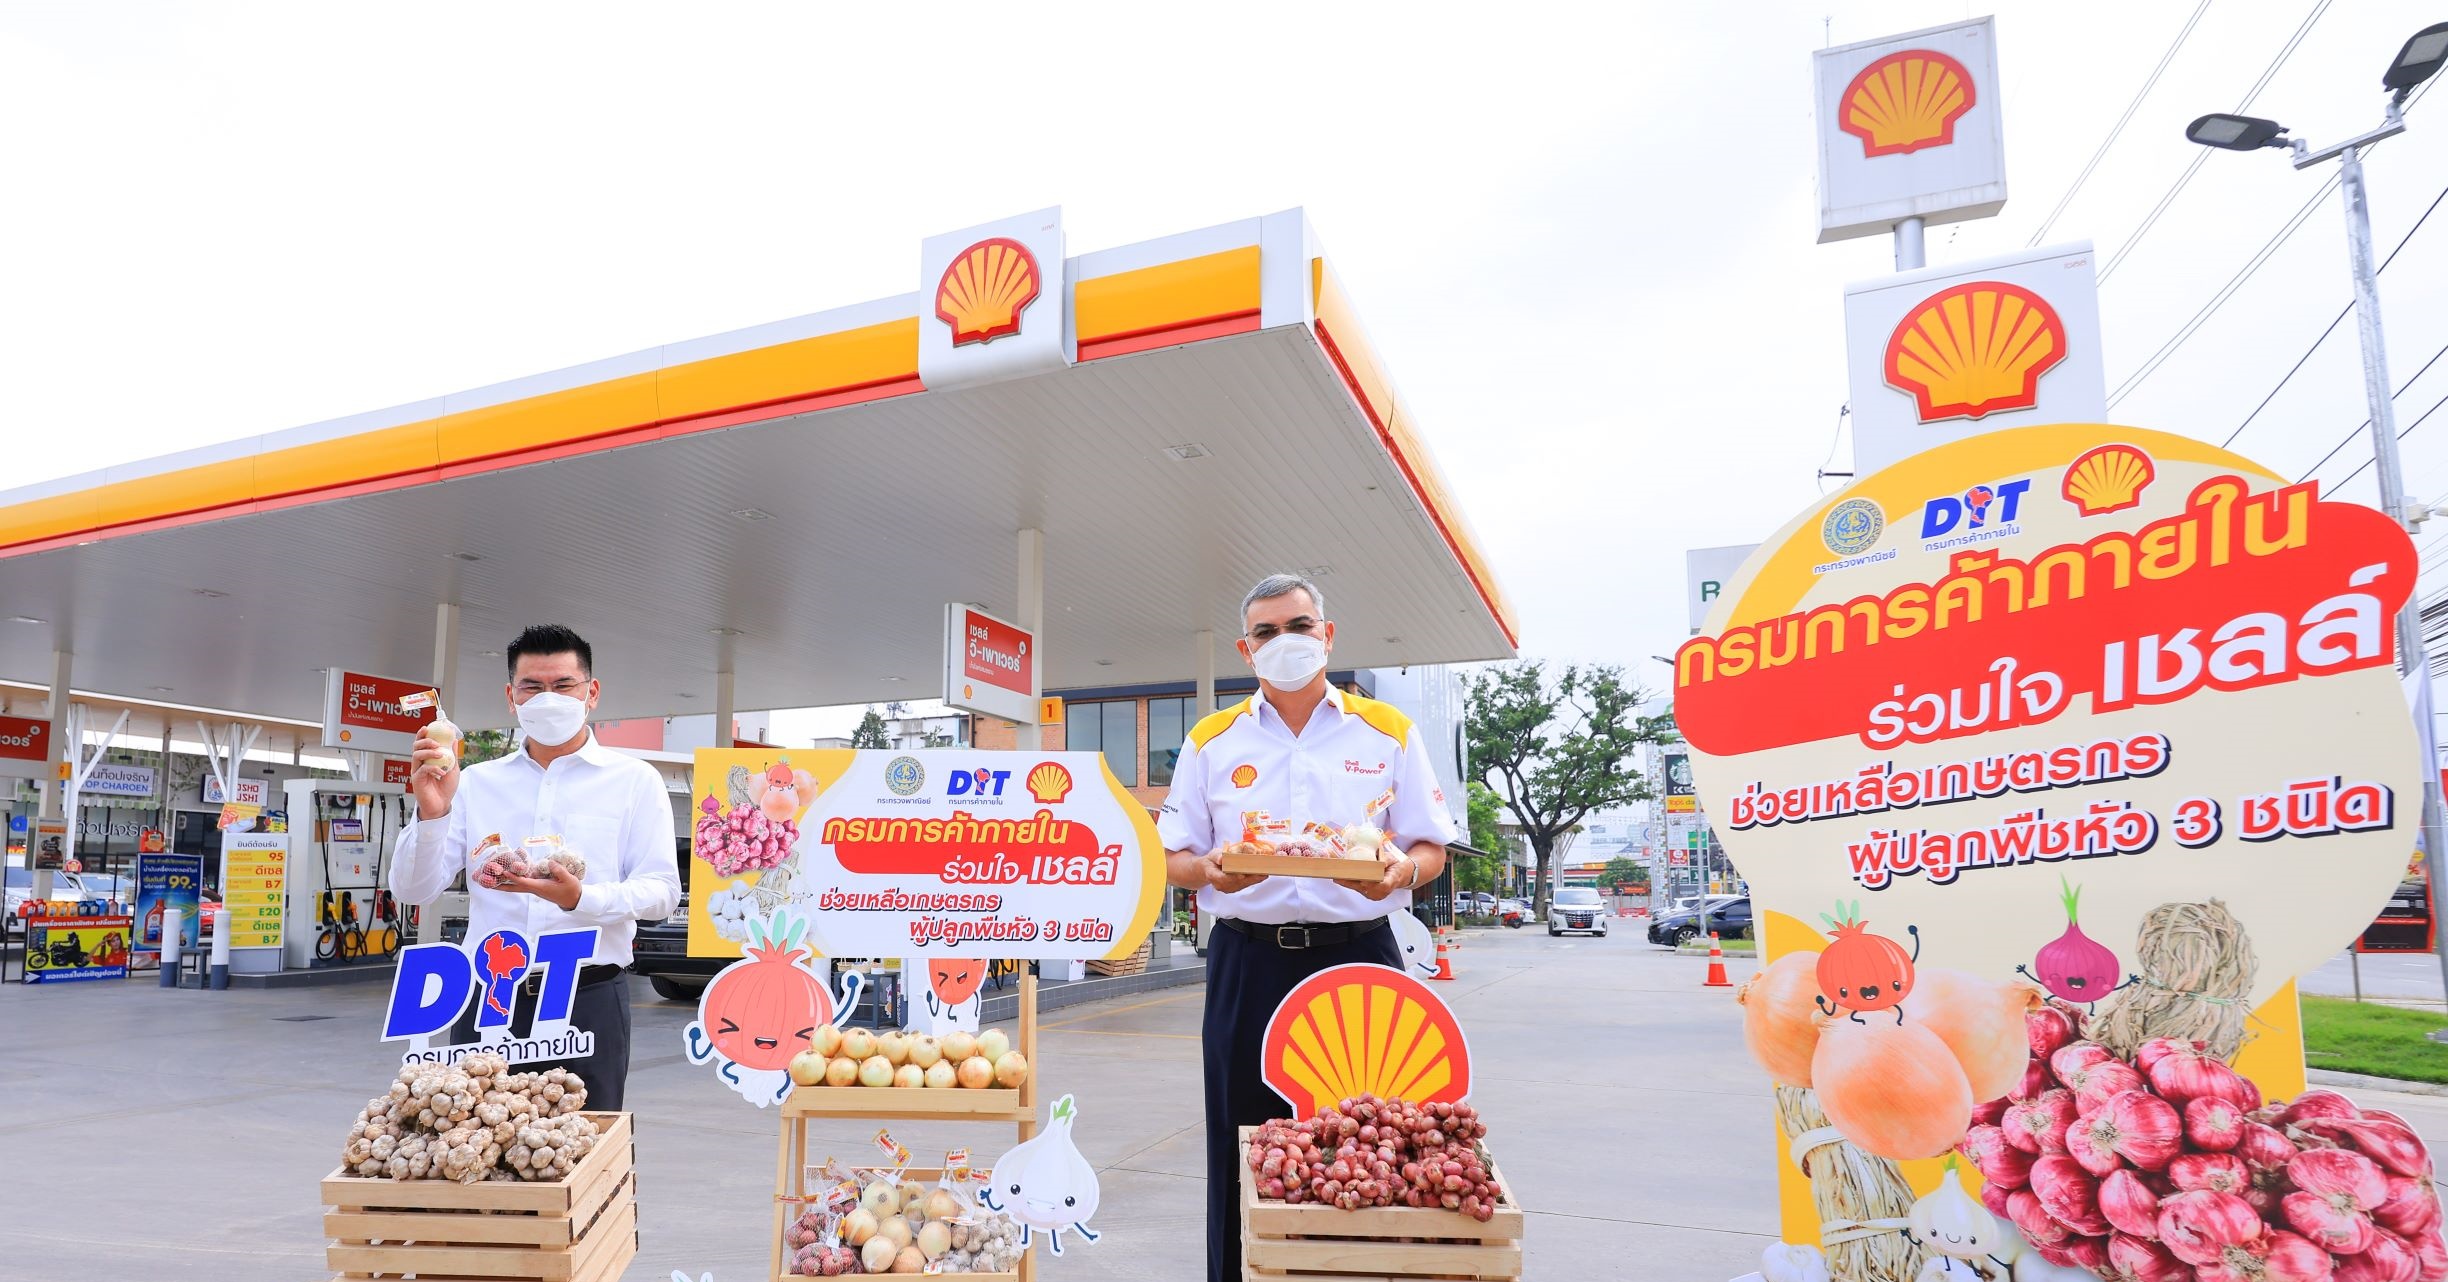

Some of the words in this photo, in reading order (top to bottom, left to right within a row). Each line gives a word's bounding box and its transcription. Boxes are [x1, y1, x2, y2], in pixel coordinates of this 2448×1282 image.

[1921, 479, 2031, 539] DIT
[1925, 523, 2020, 552] กรมการค้าภายใน
[1814, 549, 1897, 574] กระทรวงพาณิชย์
[1677, 480, 2314, 688] กรมการค้าภายใน
[970, 624, 989, 640] เชลล์
[1868, 657, 2063, 744] ร่วมใจ
[2103, 562, 2388, 705] เชลล์
[349, 683, 376, 695] เชลล์
[1046, 703, 1053, 718] 1
[0, 735, 32, 748] วอร์
[101, 781, 149, 792] CHAROEN
[946, 767, 1011, 795] DIT
[1730, 730, 2168, 830] ช่วยเหลือเกษตรกร
[877, 797, 931, 805] กระทรวงพาณิชย์
[948, 797, 1003, 806] กรมการค้าภายใน
[824, 811, 1069, 845] กรมการค้าภายใน
[1847, 802, 2157, 889] ผู้ปลูกพืชหัว
[2172, 798, 2219, 846] 3
[2240, 777, 2396, 841] ชนิด
[237, 840, 278, 848] ยินดีต้อนรับ
[268, 852, 284, 862] 95
[943, 853, 1020, 882] ร่วมใจ
[1030, 847, 1120, 883] เชลล์
[255, 865, 283, 875] ดีเซล
[267, 893, 281, 902] 91
[819, 887, 1001, 911] ช่วยเหลือเกษตรกร
[258, 907, 281, 916] E20
[253, 920, 281, 931] ดีเซล
[909, 915, 1038, 946] ผู้ปลูกพืชหัว
[1043, 920, 1060, 940] 3
[1065, 917, 1113, 942] ชนิด
[386, 930, 598, 1038] DIT
[405, 1030, 590, 1066] กรมกค้าภายใน
